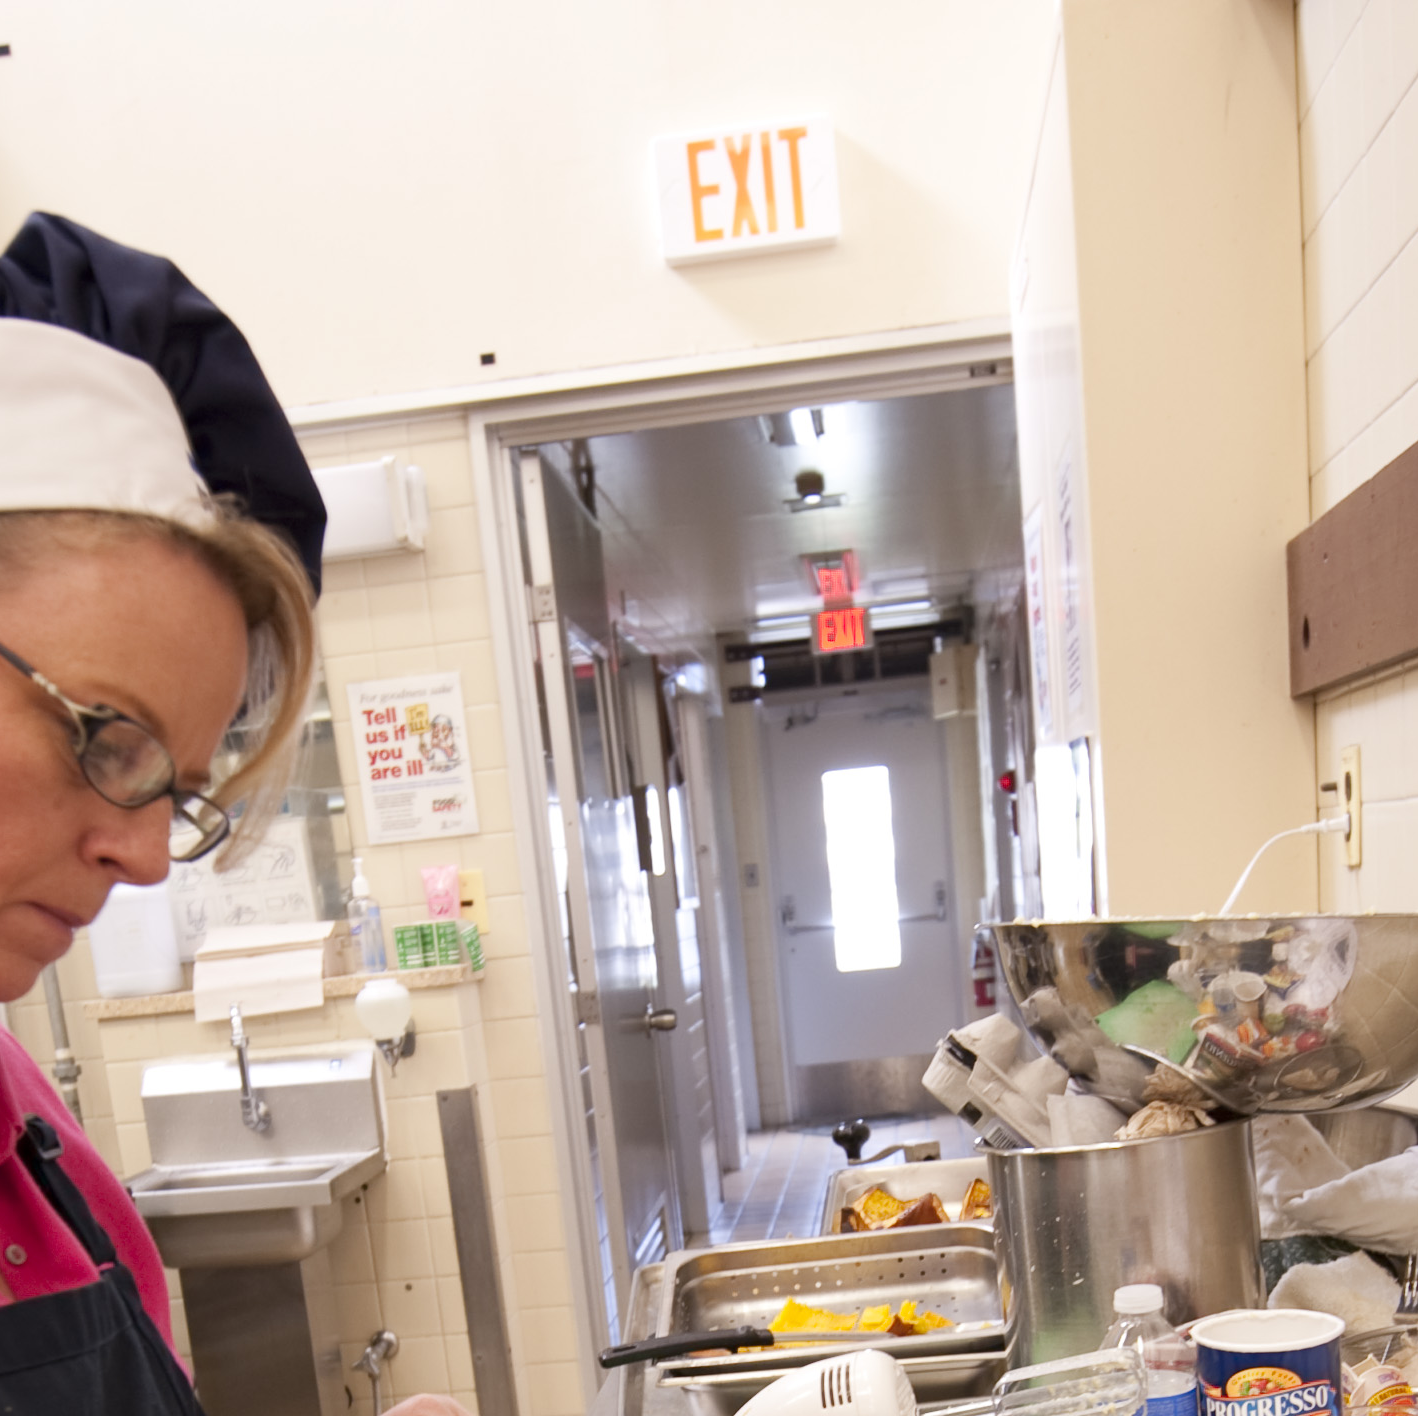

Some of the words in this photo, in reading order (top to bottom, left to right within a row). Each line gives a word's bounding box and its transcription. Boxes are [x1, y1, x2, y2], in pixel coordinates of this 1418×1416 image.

[686, 126, 808, 244] EXIT
[818, 607, 865, 652] EXIT
[362, 707, 397, 726] Tell
[365, 729, 389, 744] us
[393, 724, 407, 741] if
[367, 746, 403, 766] you
[370, 764, 402, 781] are
[406, 759, 424, 777] ill
